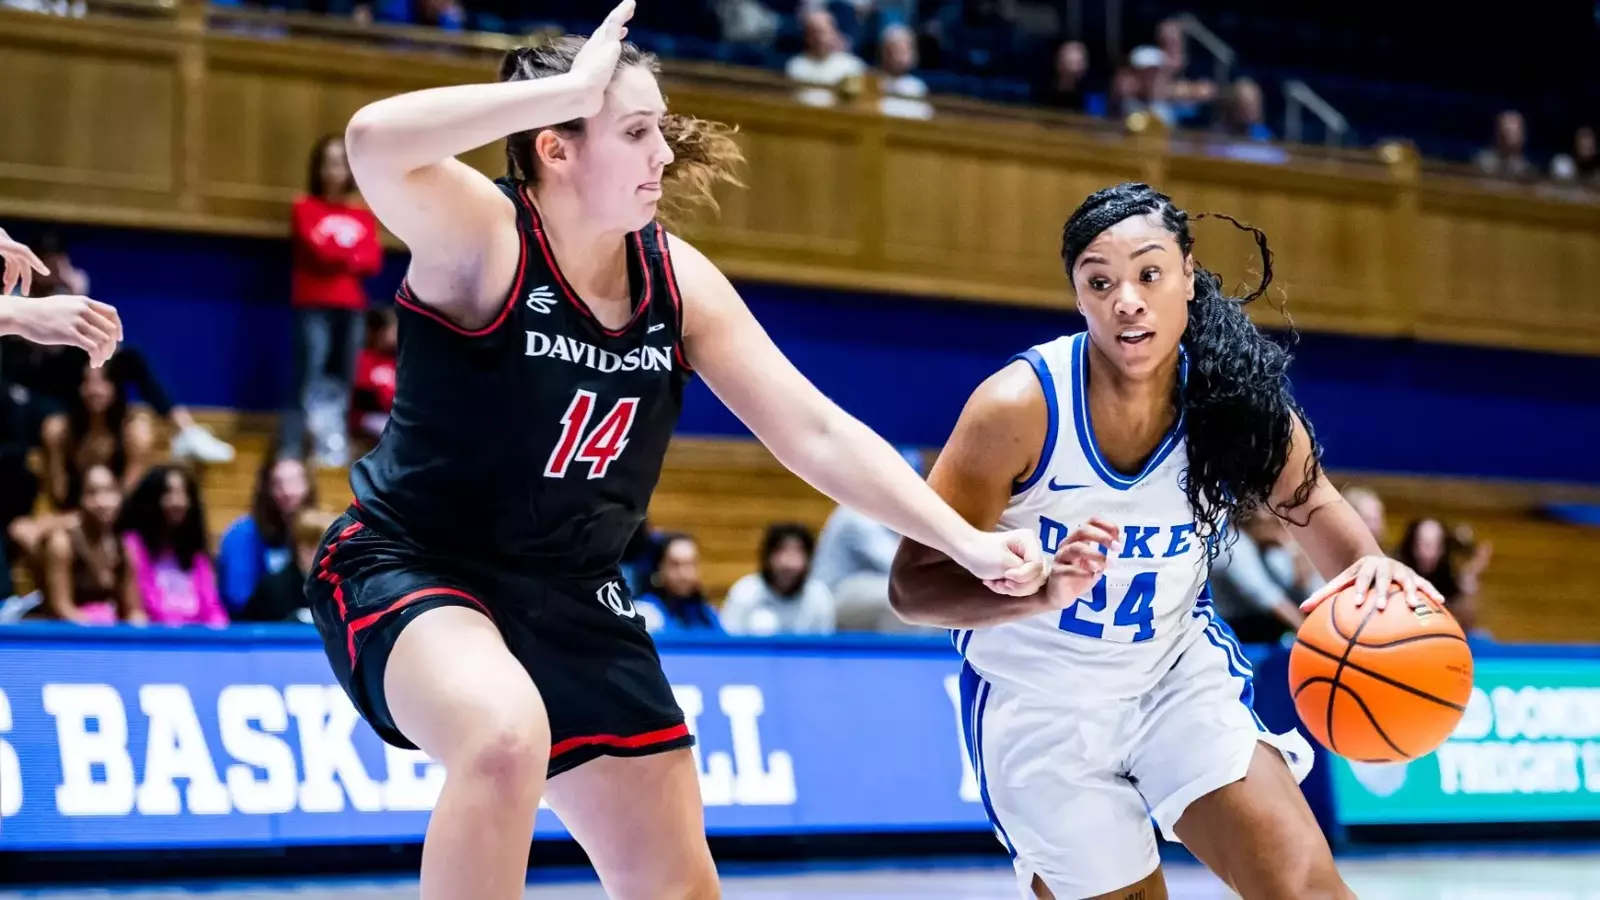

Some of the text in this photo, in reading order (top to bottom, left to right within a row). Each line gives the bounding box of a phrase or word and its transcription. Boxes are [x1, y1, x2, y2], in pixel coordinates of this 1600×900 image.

[524, 330, 673, 374] DAVIDSON
[543, 388, 641, 480] 14
[1039, 515, 1197, 559] DKE
[1058, 571, 1158, 643] 24
[42, 683, 797, 816] BASKELL
